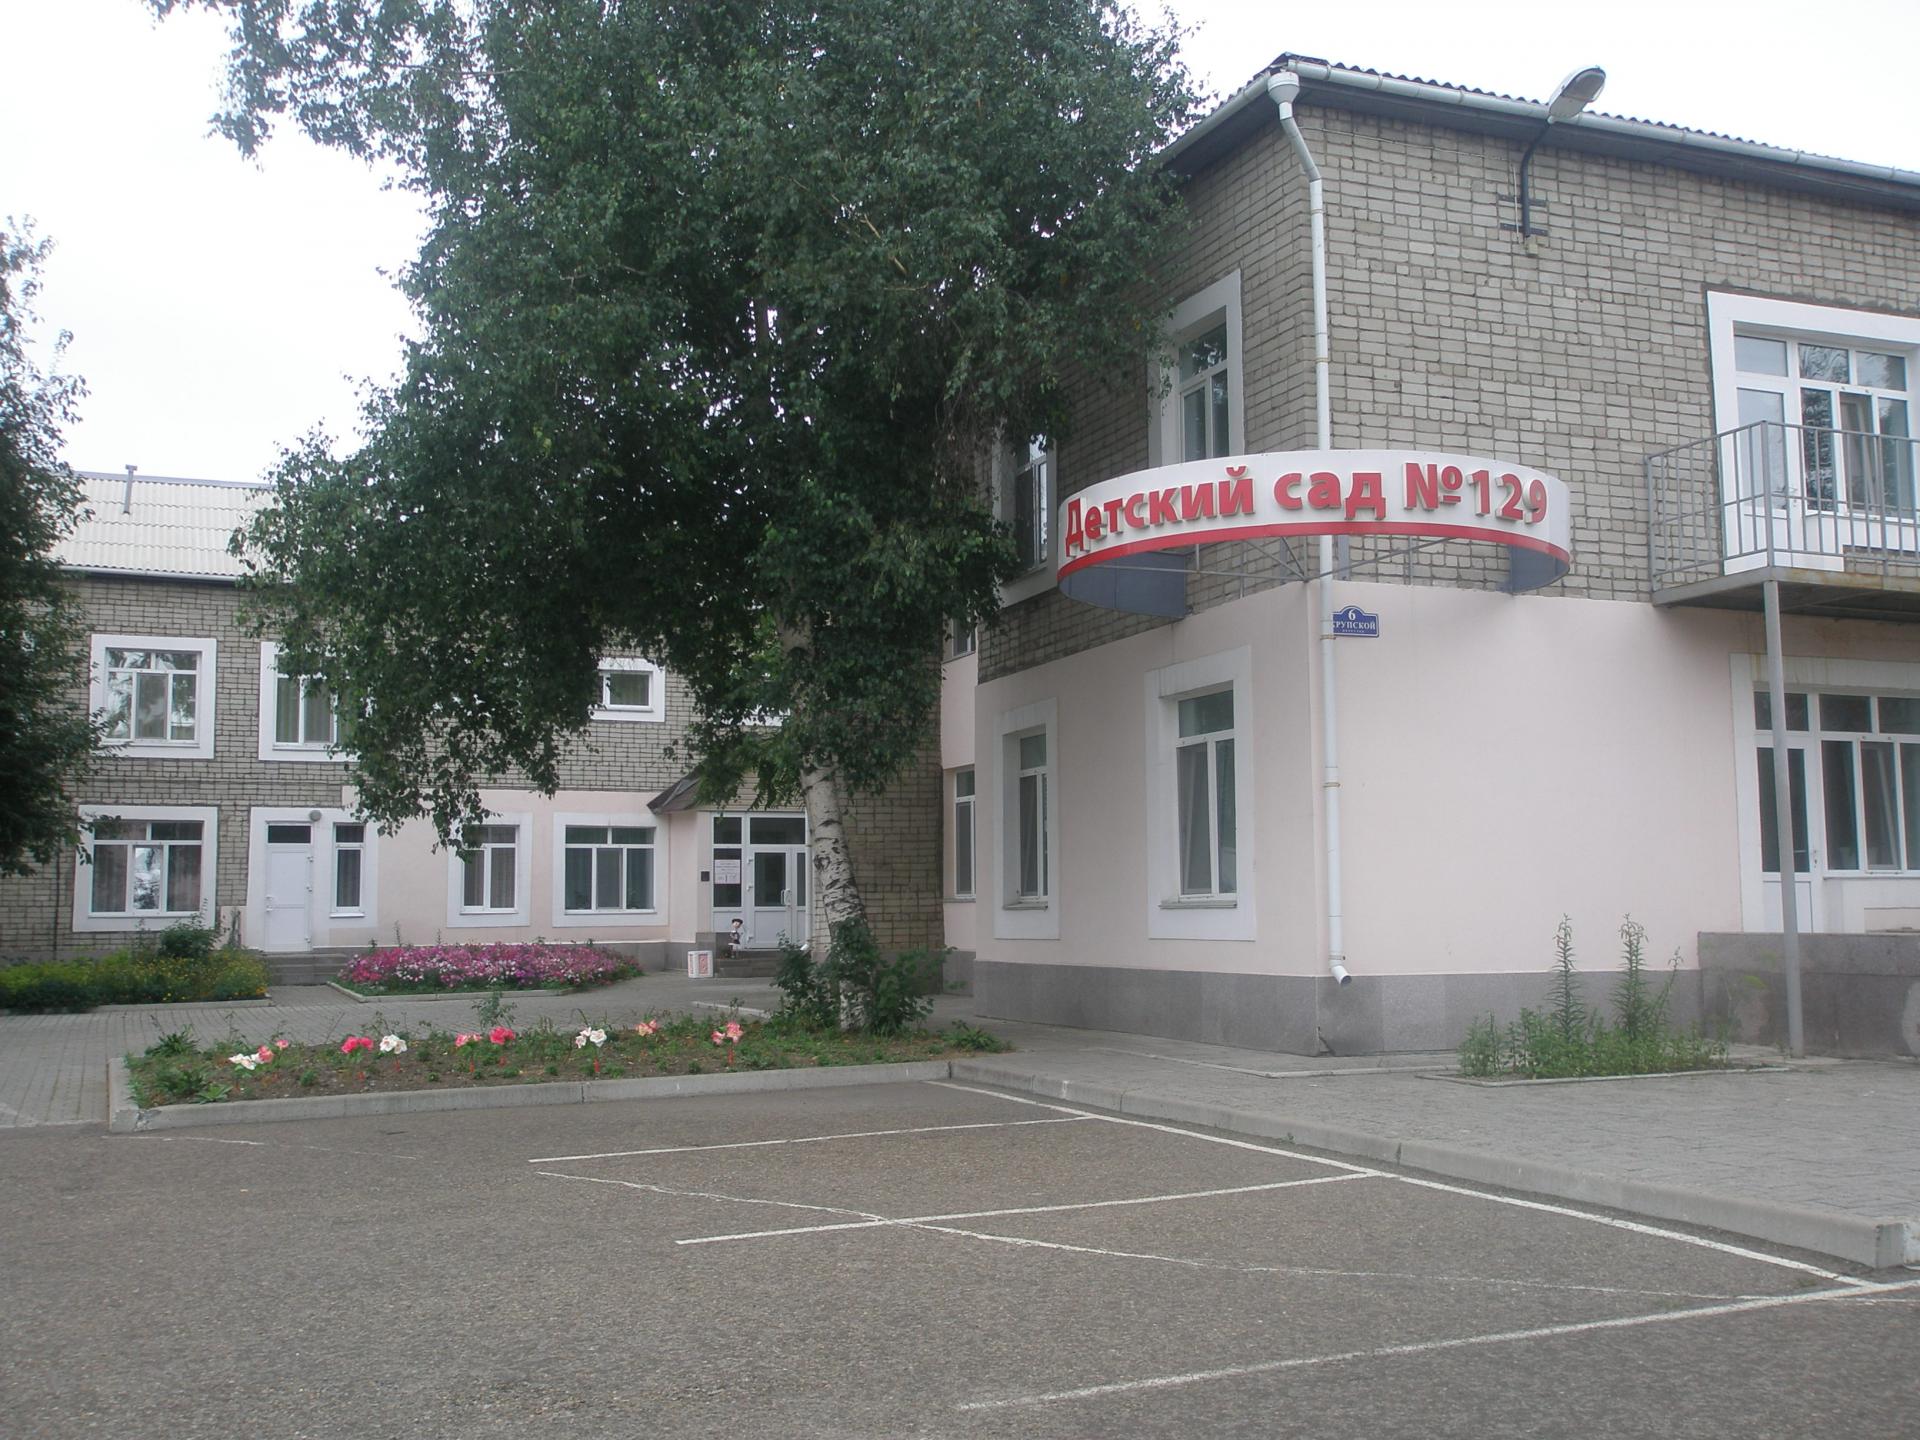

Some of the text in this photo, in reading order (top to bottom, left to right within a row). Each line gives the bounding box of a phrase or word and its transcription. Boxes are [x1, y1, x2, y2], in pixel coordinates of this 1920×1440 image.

[1065, 466, 1254, 555] Детский
[1274, 471, 1387, 519] сад
[1348, 609, 1356, 620] 6
